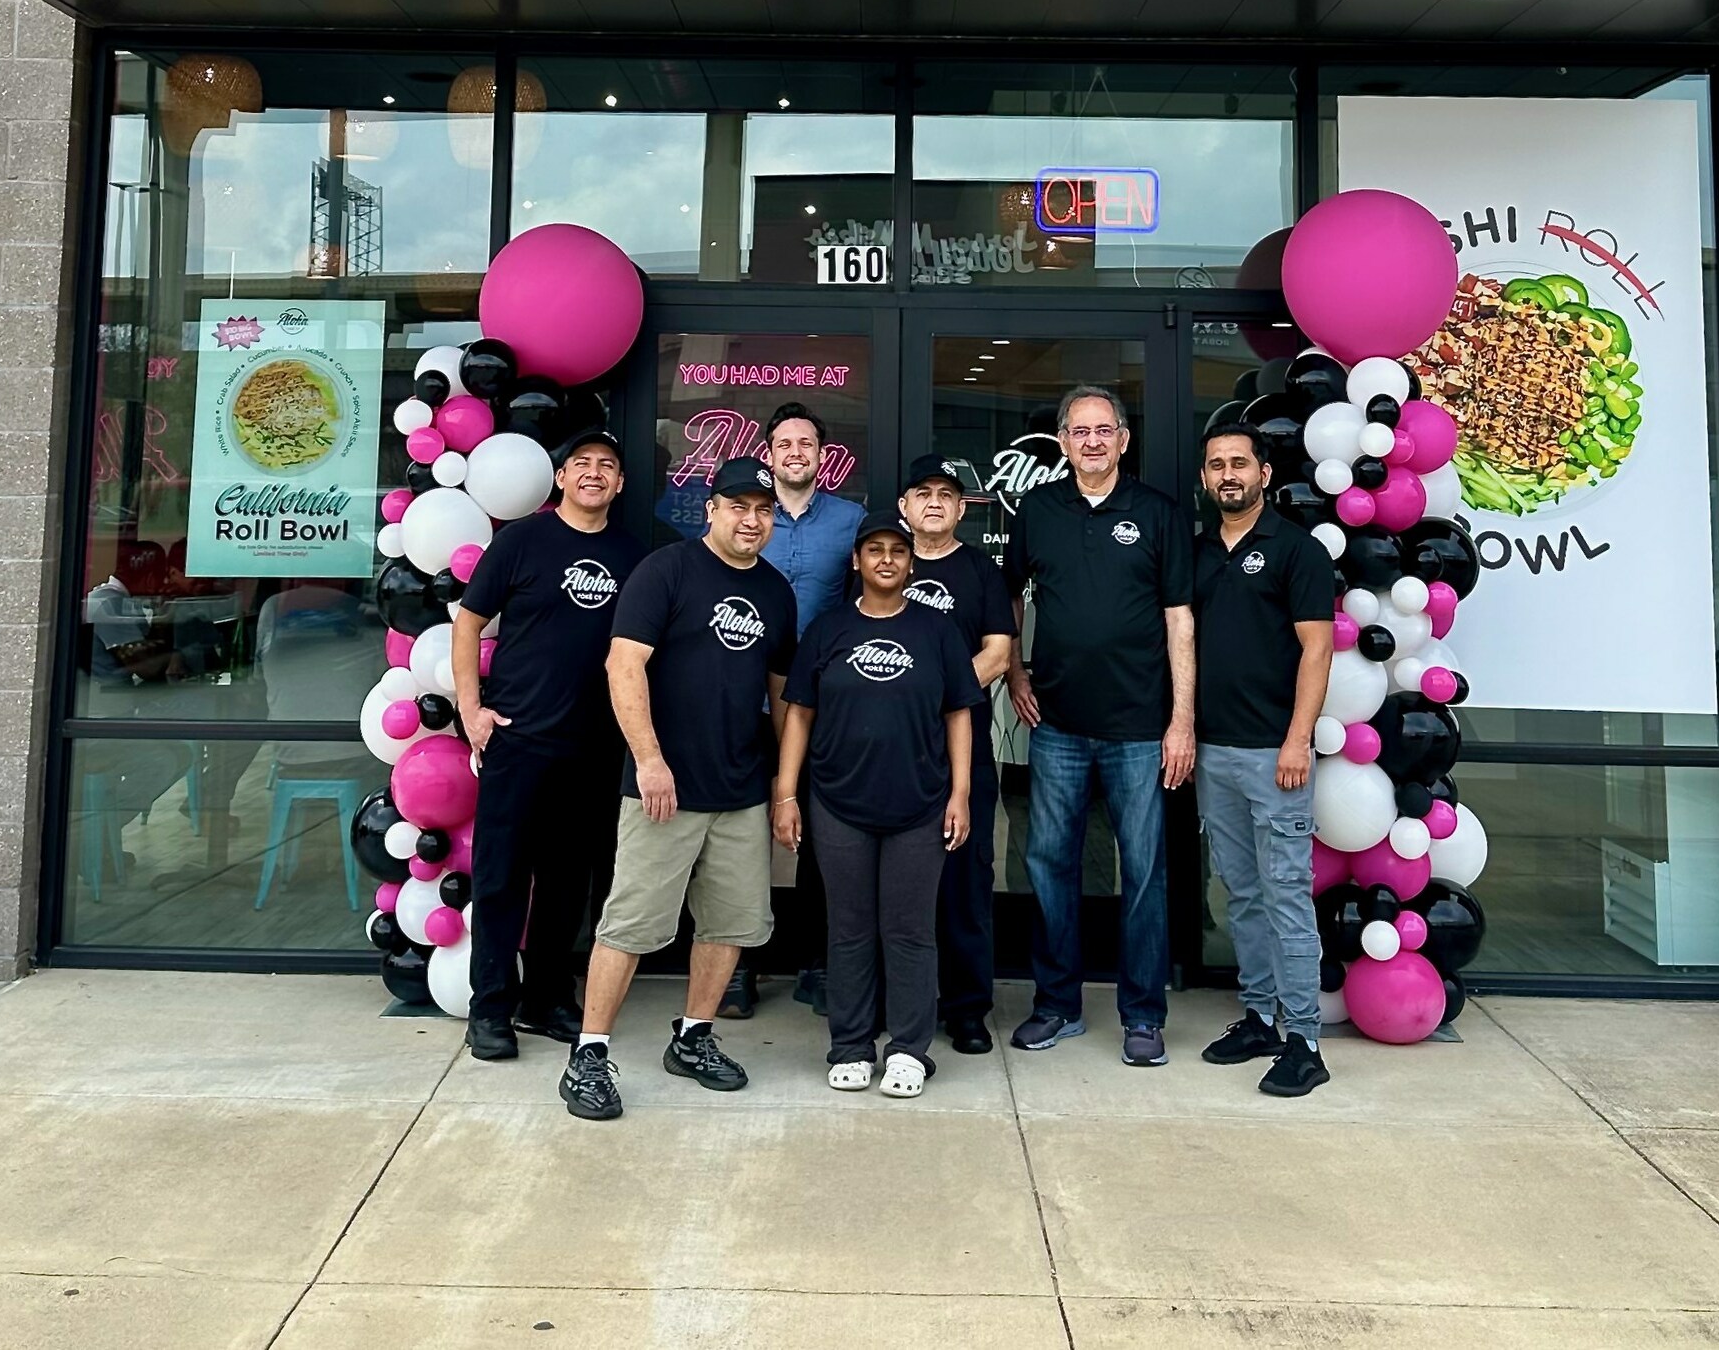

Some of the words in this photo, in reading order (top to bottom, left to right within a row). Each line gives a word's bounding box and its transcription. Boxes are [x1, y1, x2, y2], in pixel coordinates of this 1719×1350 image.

[1044, 176, 1154, 226] OPEN
[822, 247, 884, 283] 160
[1540, 210, 1665, 320] ROLL
[229, 331, 255, 342] BOWL
[217, 387, 228, 406] Crab
[225, 367, 241, 386] Salad
[334, 362, 354, 387] Crunch
[680, 364, 728, 385] YOU
[731, 365, 780, 386] HAD
[783, 366, 815, 386] ME
[820, 366, 849, 386] AT
[214, 483, 351, 518] California
[215, 519, 269, 541] Roll
[280, 519, 349, 541] Bowl
[1453, 513, 1610, 575] OWL
